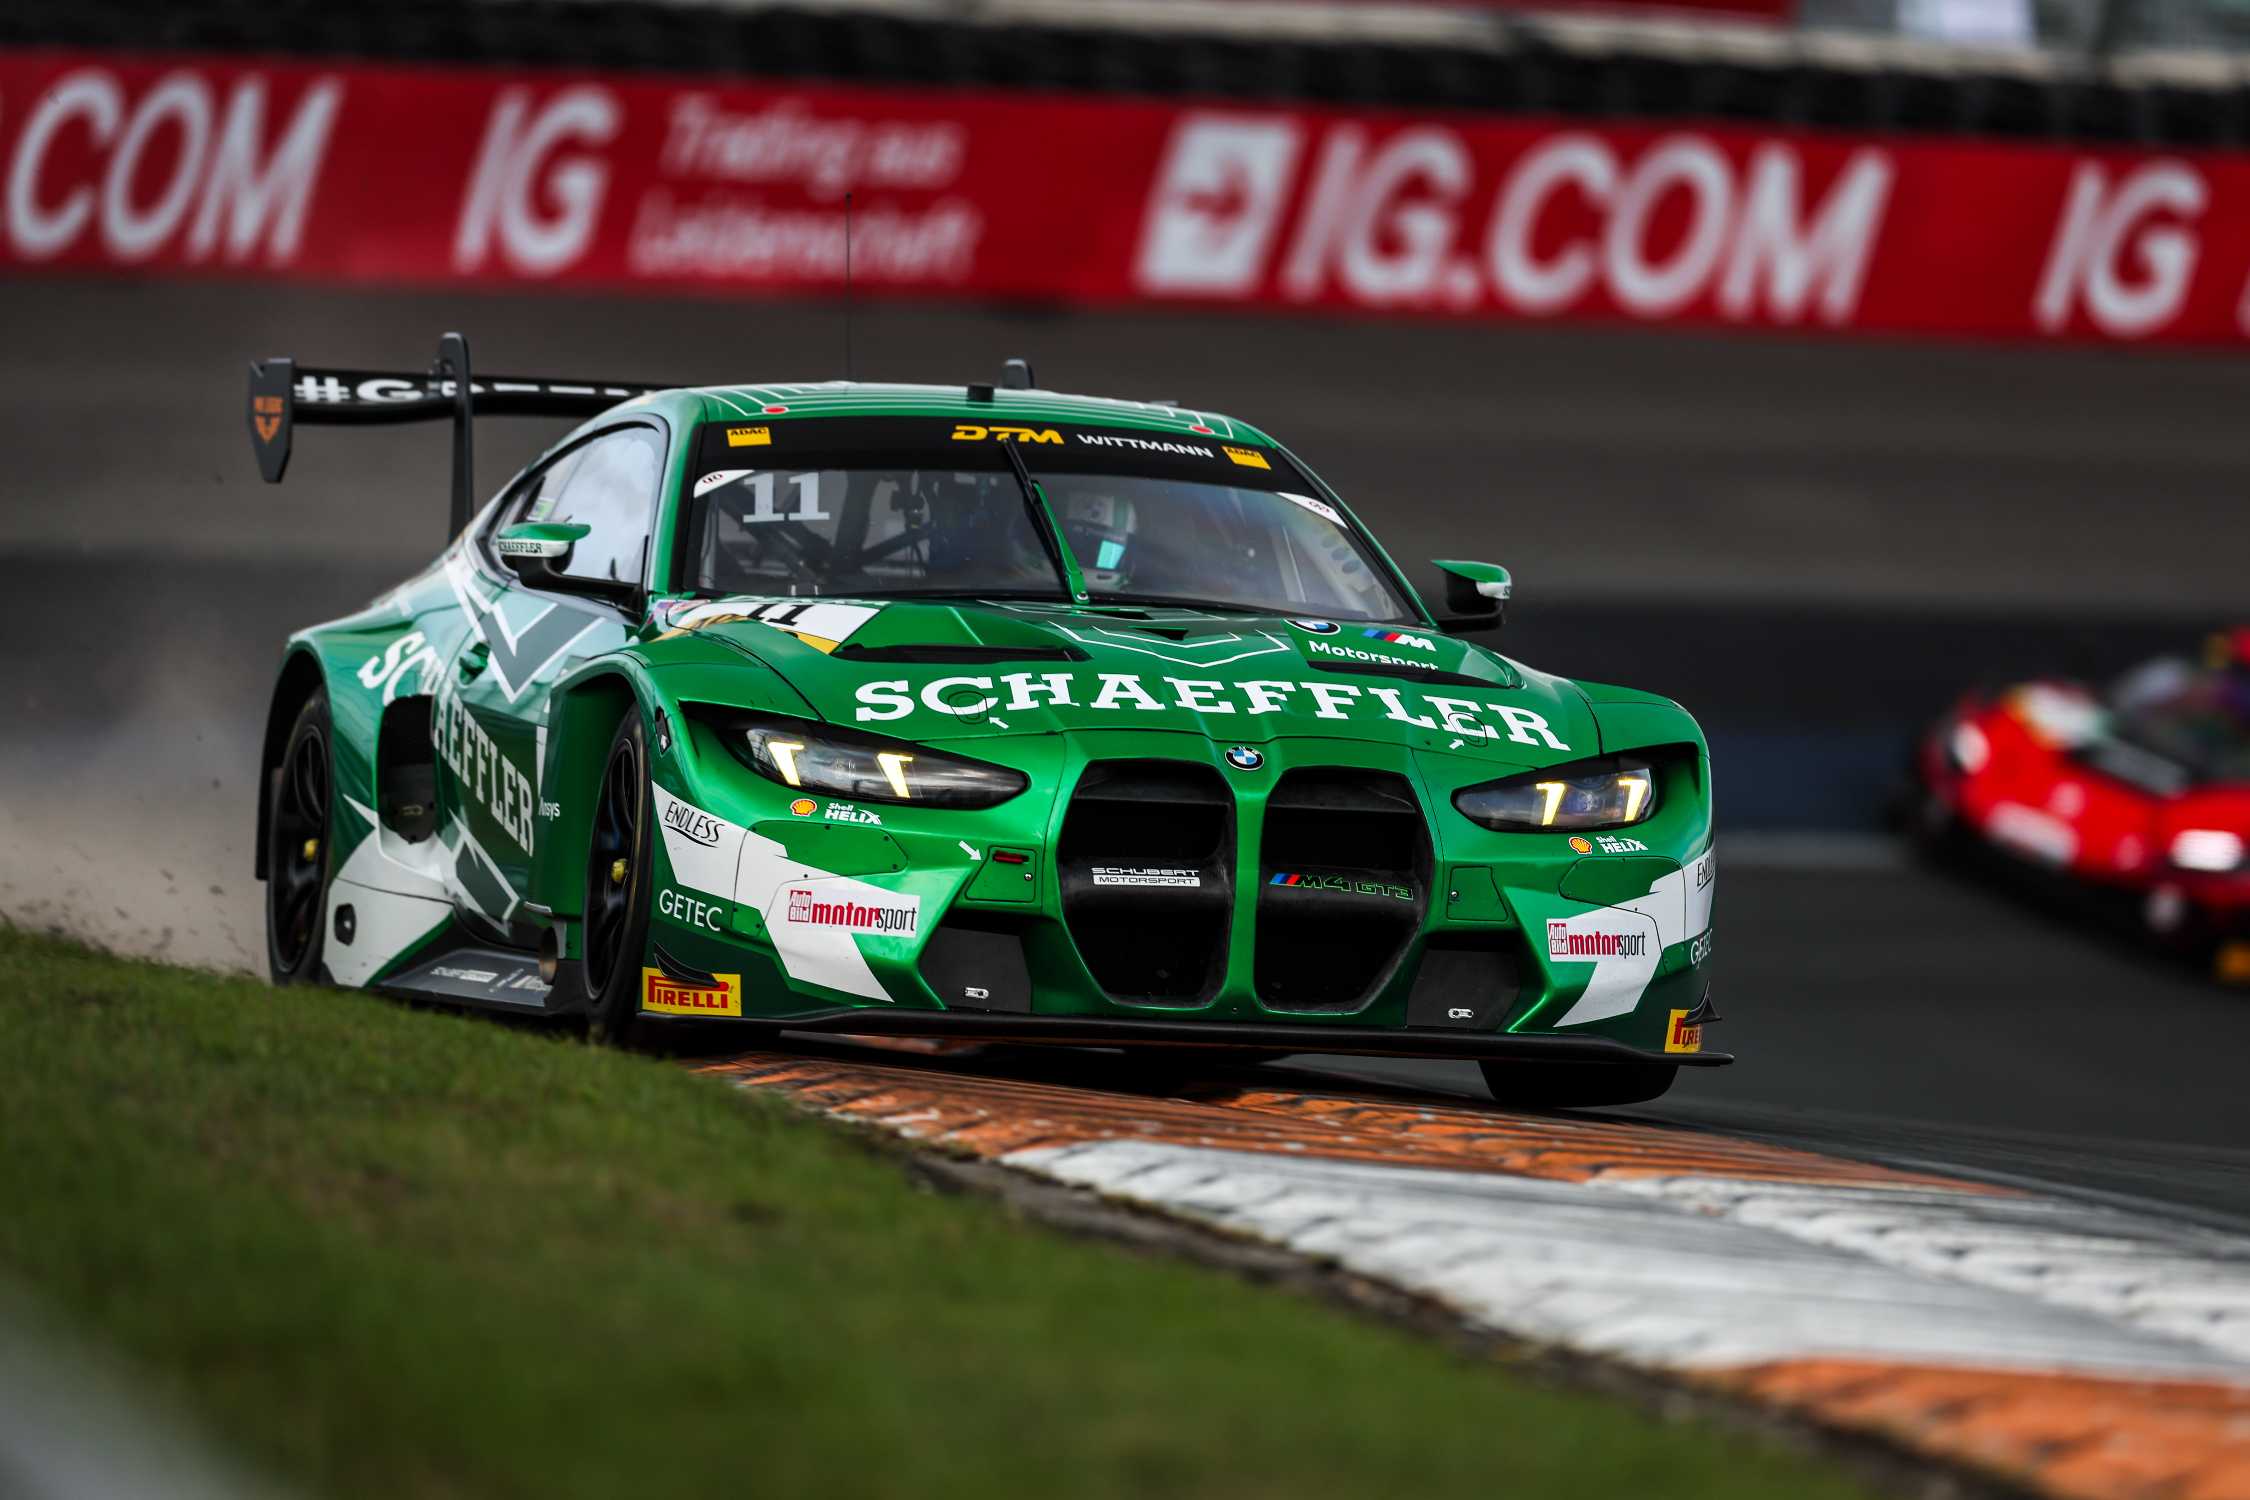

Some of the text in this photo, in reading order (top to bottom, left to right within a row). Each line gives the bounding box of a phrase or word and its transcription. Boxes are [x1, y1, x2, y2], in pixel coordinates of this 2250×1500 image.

[452, 84, 622, 272] IG
[1286, 125, 1893, 320] IG.COM
[2034, 160, 2207, 336] IG
[730, 427, 767, 437] ADAC
[952, 425, 1214, 458] DTM WITTMANN
[743, 472, 830, 523] 11
[747, 603, 815, 626] 11
[1308, 640, 1439, 672] Motorsport
[855, 672, 1572, 752] SCHAEFFLER
[665, 800, 725, 843] ENDLESS
[825, 809, 882, 825] HELIX
[828, 803, 854, 811] Shell
[1596, 835, 1617, 843] Shell
[1600, 838, 1648, 854] HELIX
[1091, 866, 1200, 877] SCHUBERT
[1098, 876, 1195, 886] MOTORSPORT
[1356, 881, 1414, 901] GT3
[659, 888, 723, 933] GETEC
[647, 975, 730, 1008] PIRELLI
